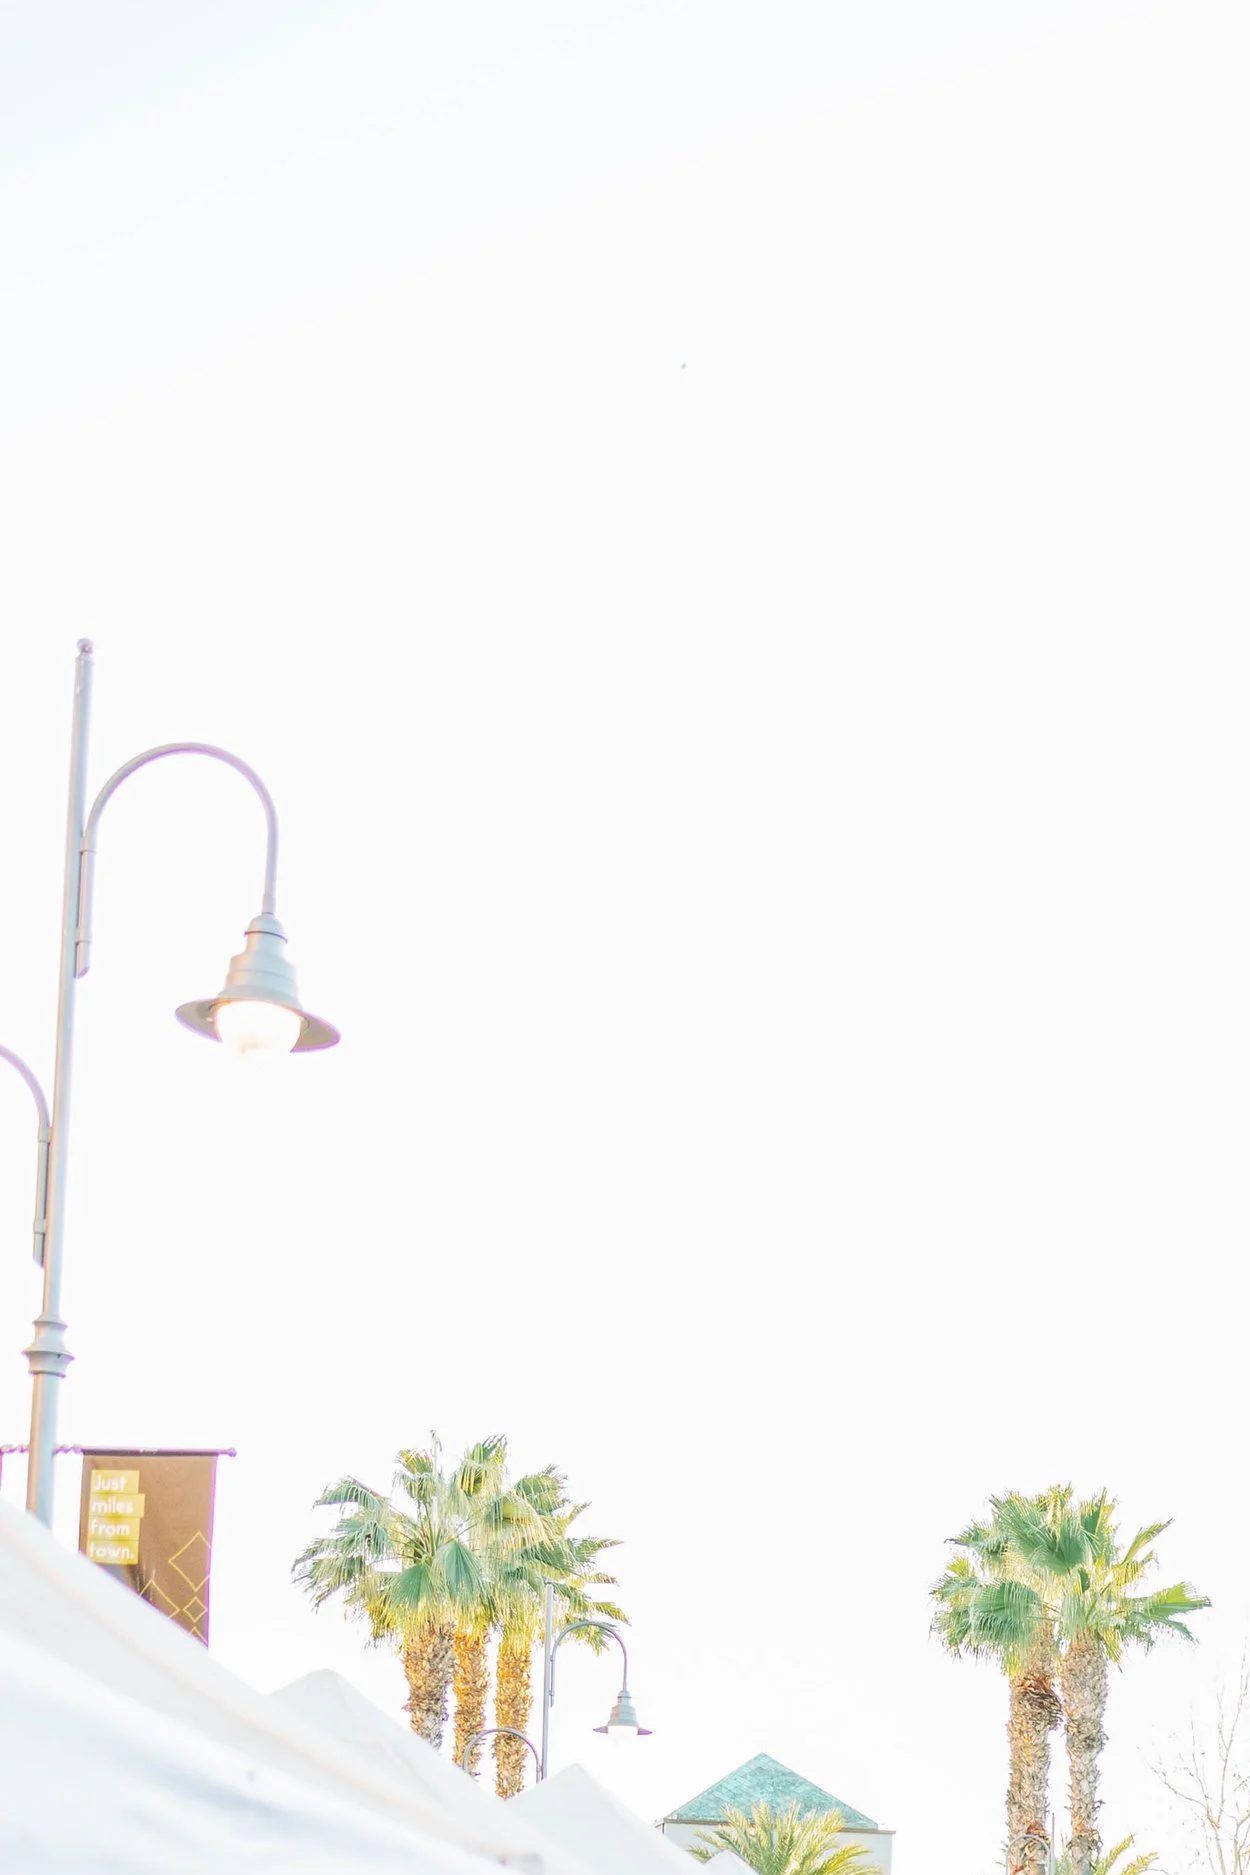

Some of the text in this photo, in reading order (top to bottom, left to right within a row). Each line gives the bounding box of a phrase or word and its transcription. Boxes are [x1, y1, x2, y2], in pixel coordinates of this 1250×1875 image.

[94, 1474, 126, 1491] Just
[92, 1495, 134, 1513] miles
[90, 1518, 130, 1536] from
[89, 1543, 134, 1559] town.
